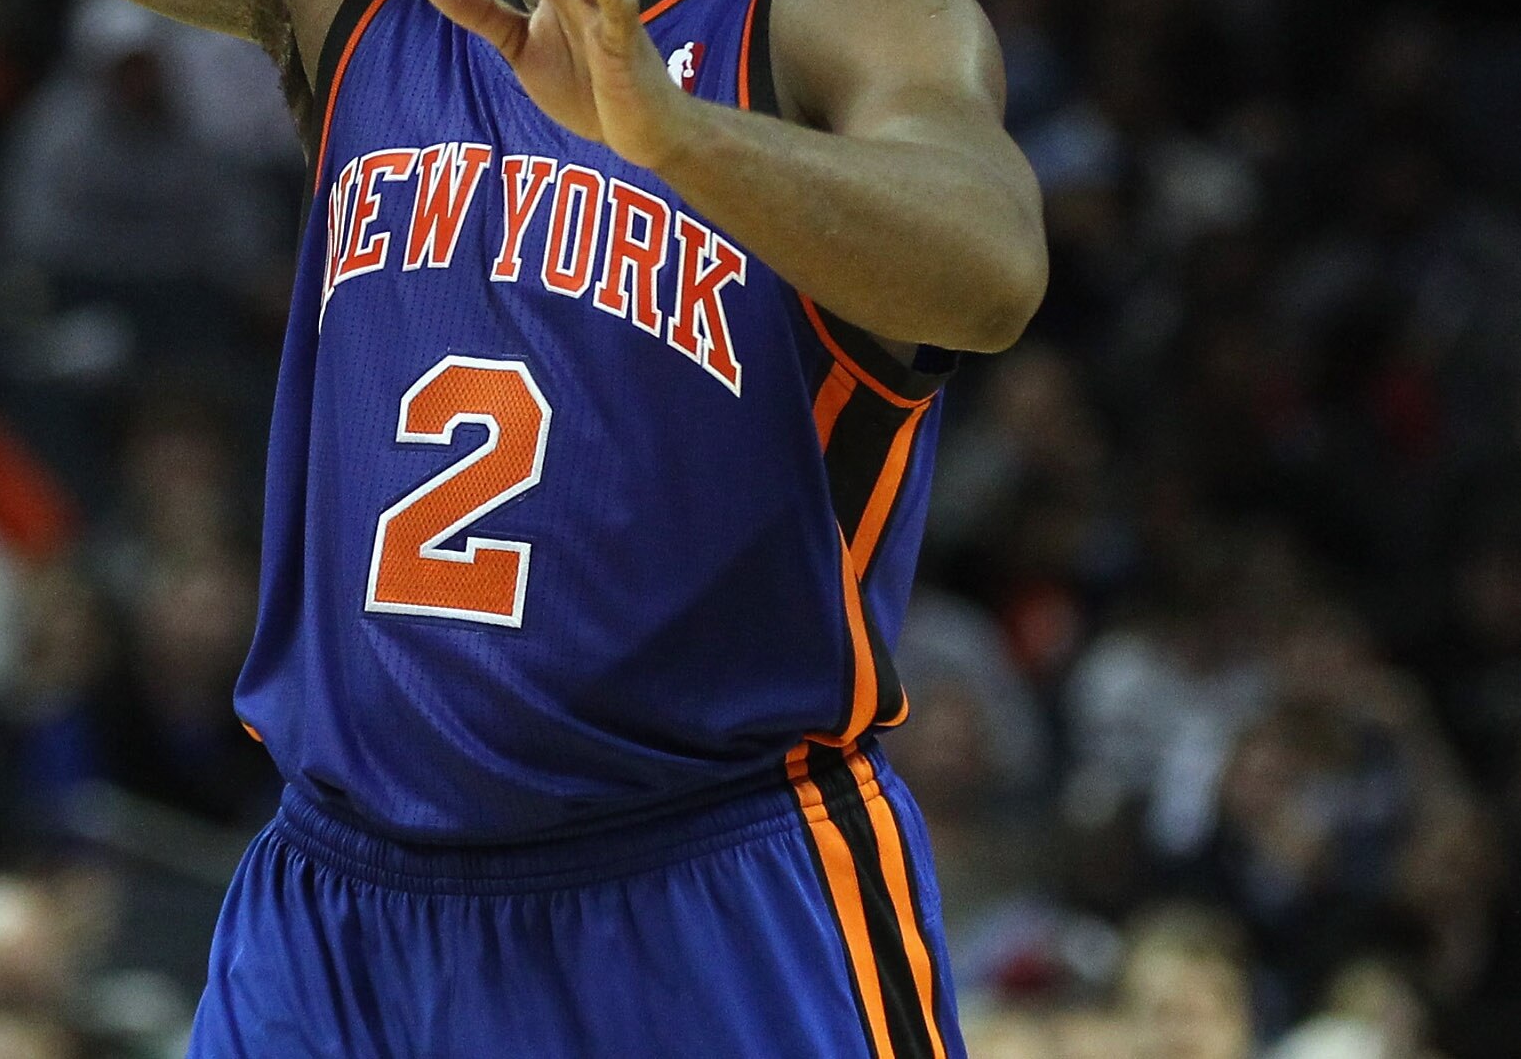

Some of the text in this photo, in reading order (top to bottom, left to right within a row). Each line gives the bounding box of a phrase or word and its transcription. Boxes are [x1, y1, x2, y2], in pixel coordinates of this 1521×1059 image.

[319, 142, 748, 398] NEW YORK
[364, 354, 553, 629] 2
